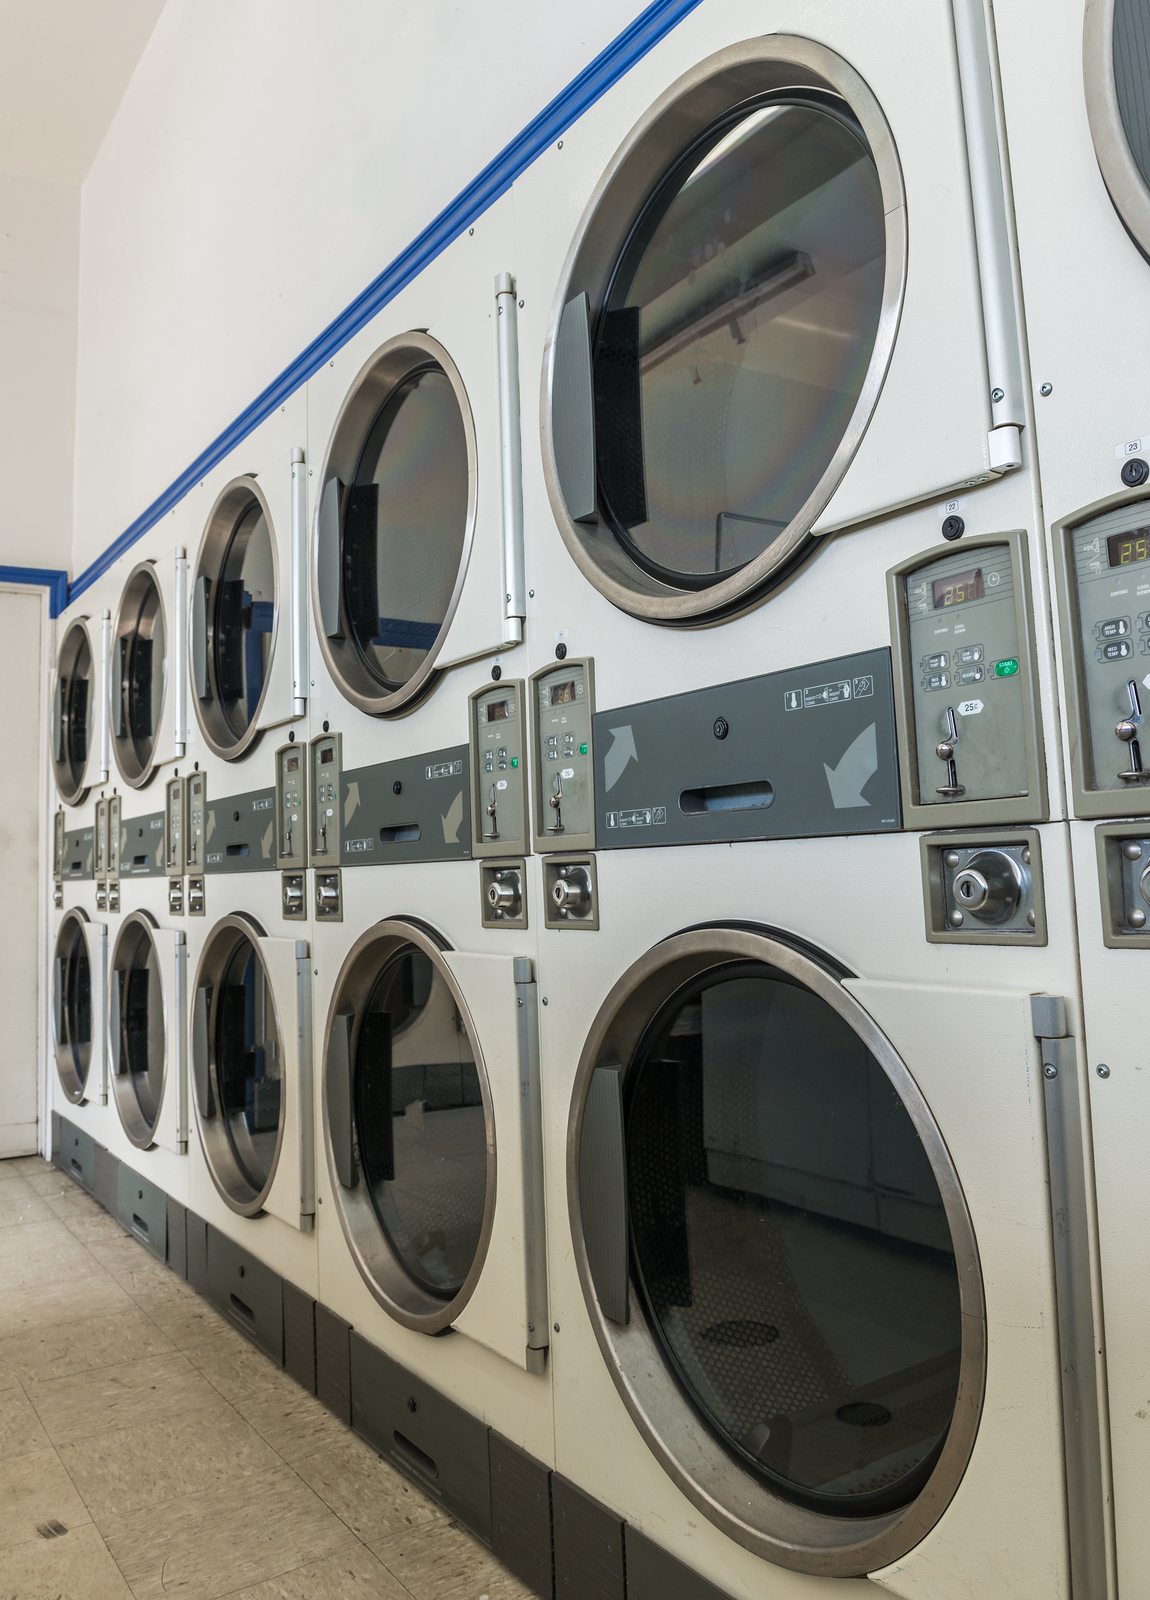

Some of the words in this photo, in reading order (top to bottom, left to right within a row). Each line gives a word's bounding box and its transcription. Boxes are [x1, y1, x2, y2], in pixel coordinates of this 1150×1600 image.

[1128, 443, 1138, 452] 23
[948, 503, 956, 511] 22
[1121, 539, 1147, 564] 25
[944, 584, 965, 606] 25
[1110, 588, 1128, 597] DRYING
